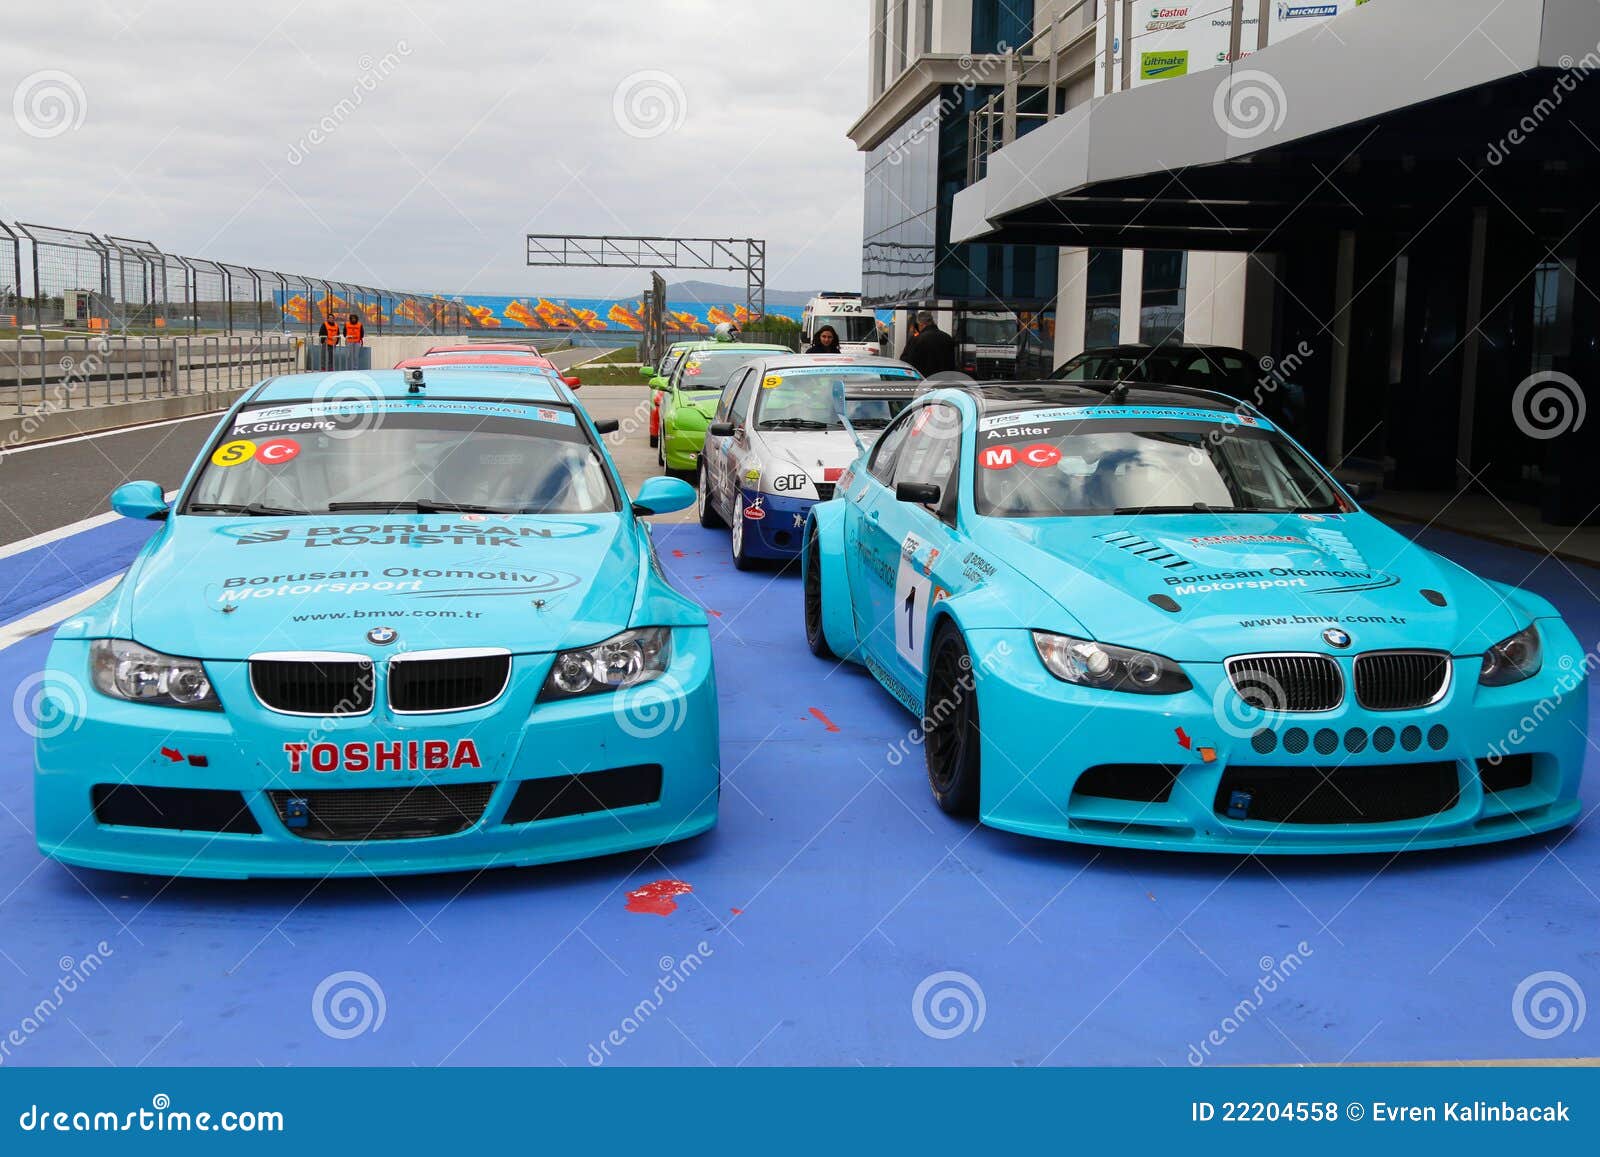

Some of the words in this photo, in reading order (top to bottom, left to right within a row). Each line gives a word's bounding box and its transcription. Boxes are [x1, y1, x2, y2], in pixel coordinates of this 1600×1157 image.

[1159, 7, 1188, 18] Castrol
[1289, 6, 1335, 16] MICHELIN
[765, 375, 778, 386] S
[232, 417, 337, 436] K.Gürgenç
[986, 424, 1051, 440] A.Biter
[222, 445, 247, 462] S
[985, 447, 1013, 465] M
[774, 474, 806, 492] elf
[306, 523, 554, 538] BORUSAN
[223, 568, 369, 588] Borusan
[382, 566, 539, 584] Otomotiv
[1163, 568, 1265, 586] Borusan
[1269, 566, 1373, 580] Otomotiv
[217, 578, 424, 602] Motorsport
[1174, 578, 1309, 597] Motorsport
[292, 608, 483, 623] www.bmw.com.tr
[905, 586, 916, 651] 1
[1238, 614, 1408, 629] www.bmw.com.tr
[283, 738, 482, 773] TOSHIBA
